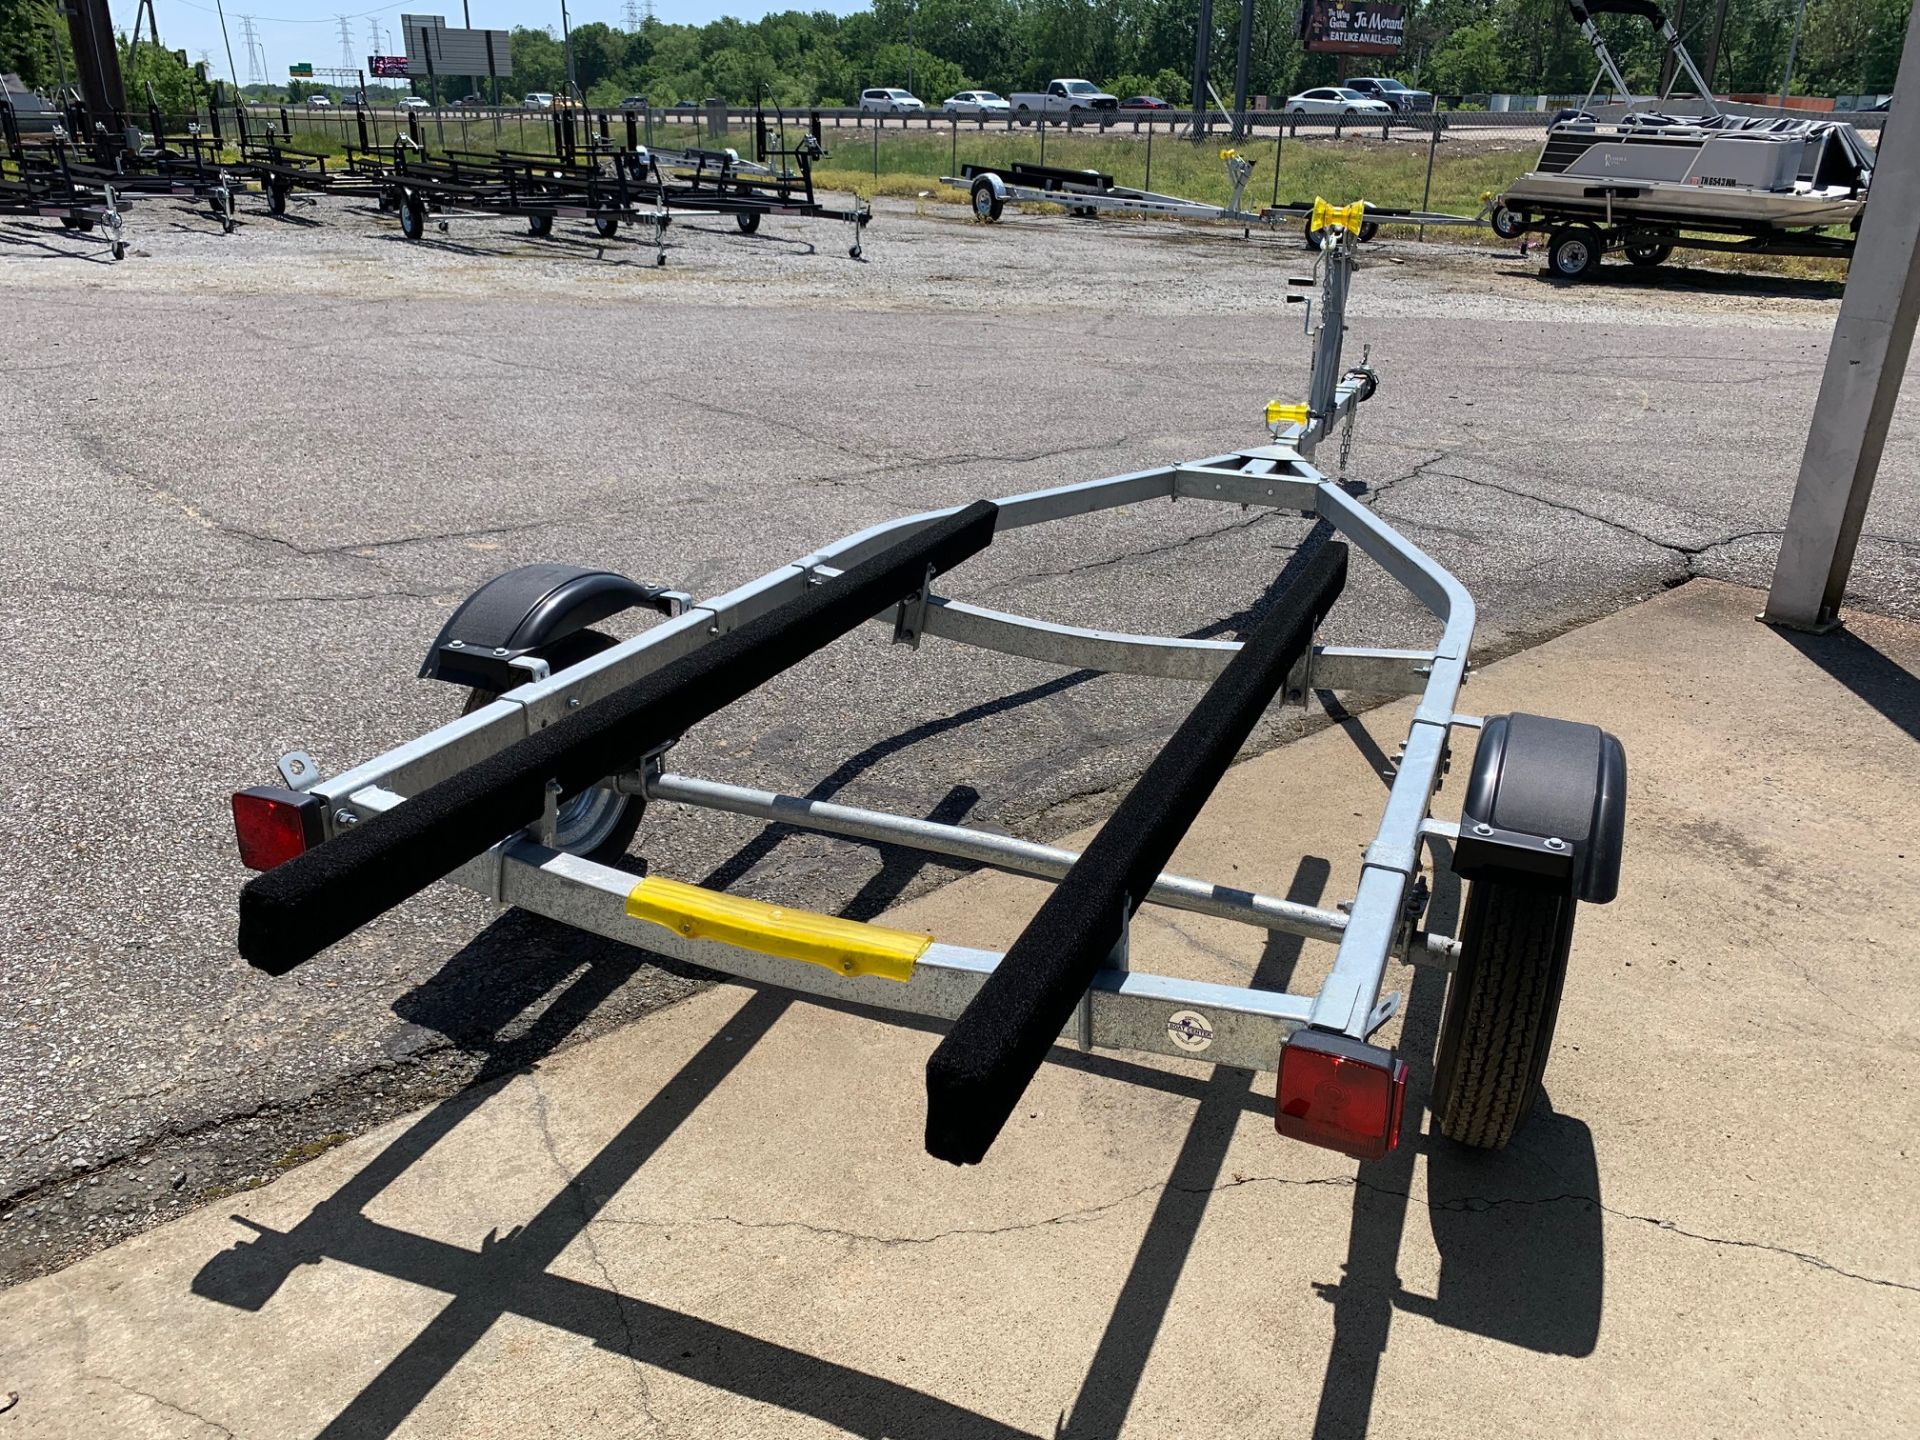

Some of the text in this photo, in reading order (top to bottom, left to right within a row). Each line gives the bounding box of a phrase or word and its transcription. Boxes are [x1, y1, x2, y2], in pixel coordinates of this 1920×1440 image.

[1354, 11, 1404, 30] Ja Morant
[1330, 31, 1402, 46] EAT LIKE AN ALL-STAR
